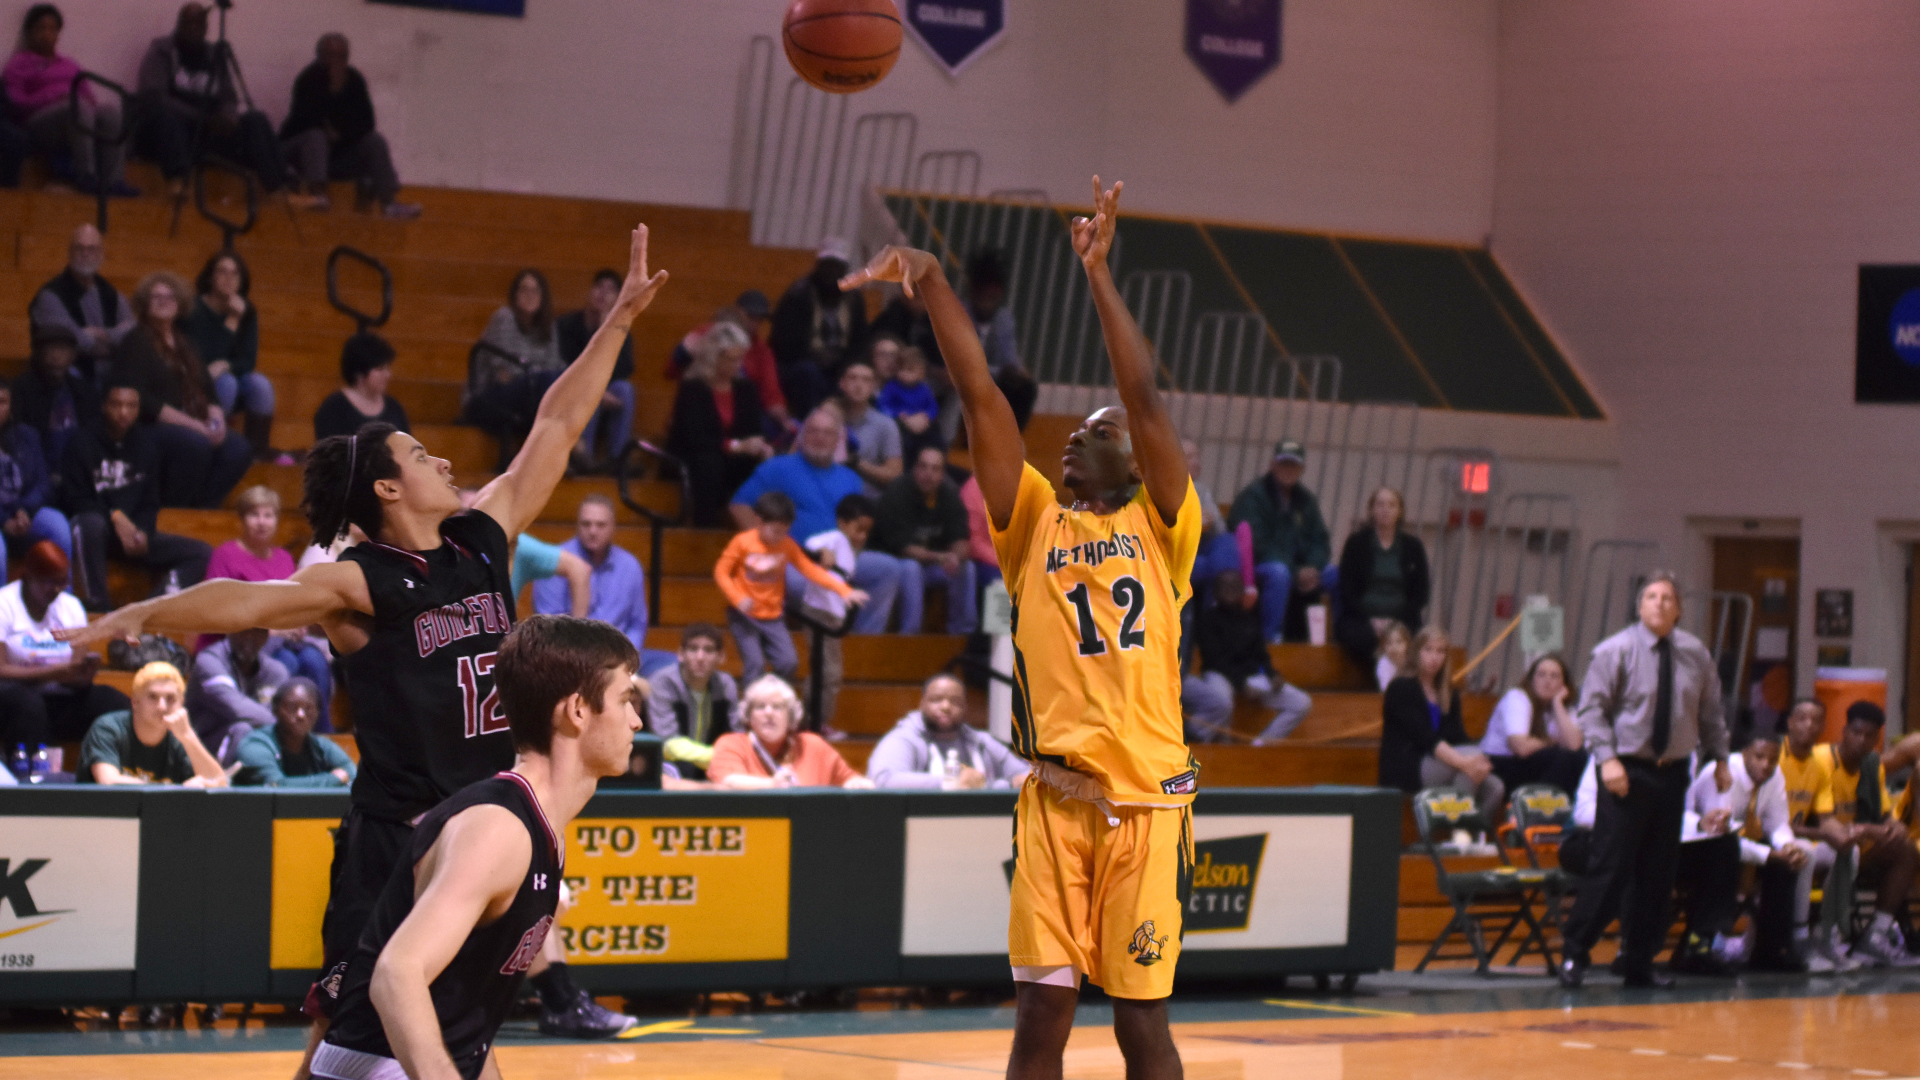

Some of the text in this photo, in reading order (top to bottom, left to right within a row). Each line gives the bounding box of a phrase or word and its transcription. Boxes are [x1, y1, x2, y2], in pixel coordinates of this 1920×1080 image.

[917, 4, 987, 30] COLLEGE
[1200, 34, 1265, 58] COLLEGE
[1895, 322, 1920, 346] NC
[1046, 532, 1146, 574] METHODIST
[1065, 574, 1146, 657] 12
[457, 651, 511, 739] 12
[577, 826, 746, 857] TO THE
[1193, 852, 1250, 888] elson
[0, 857, 55, 919] K
[564, 875, 697, 907] F THE
[1188, 892, 1247, 914] CTIC
[559, 924, 670, 956] RCHS
[0, 953, 35, 968] 1938
